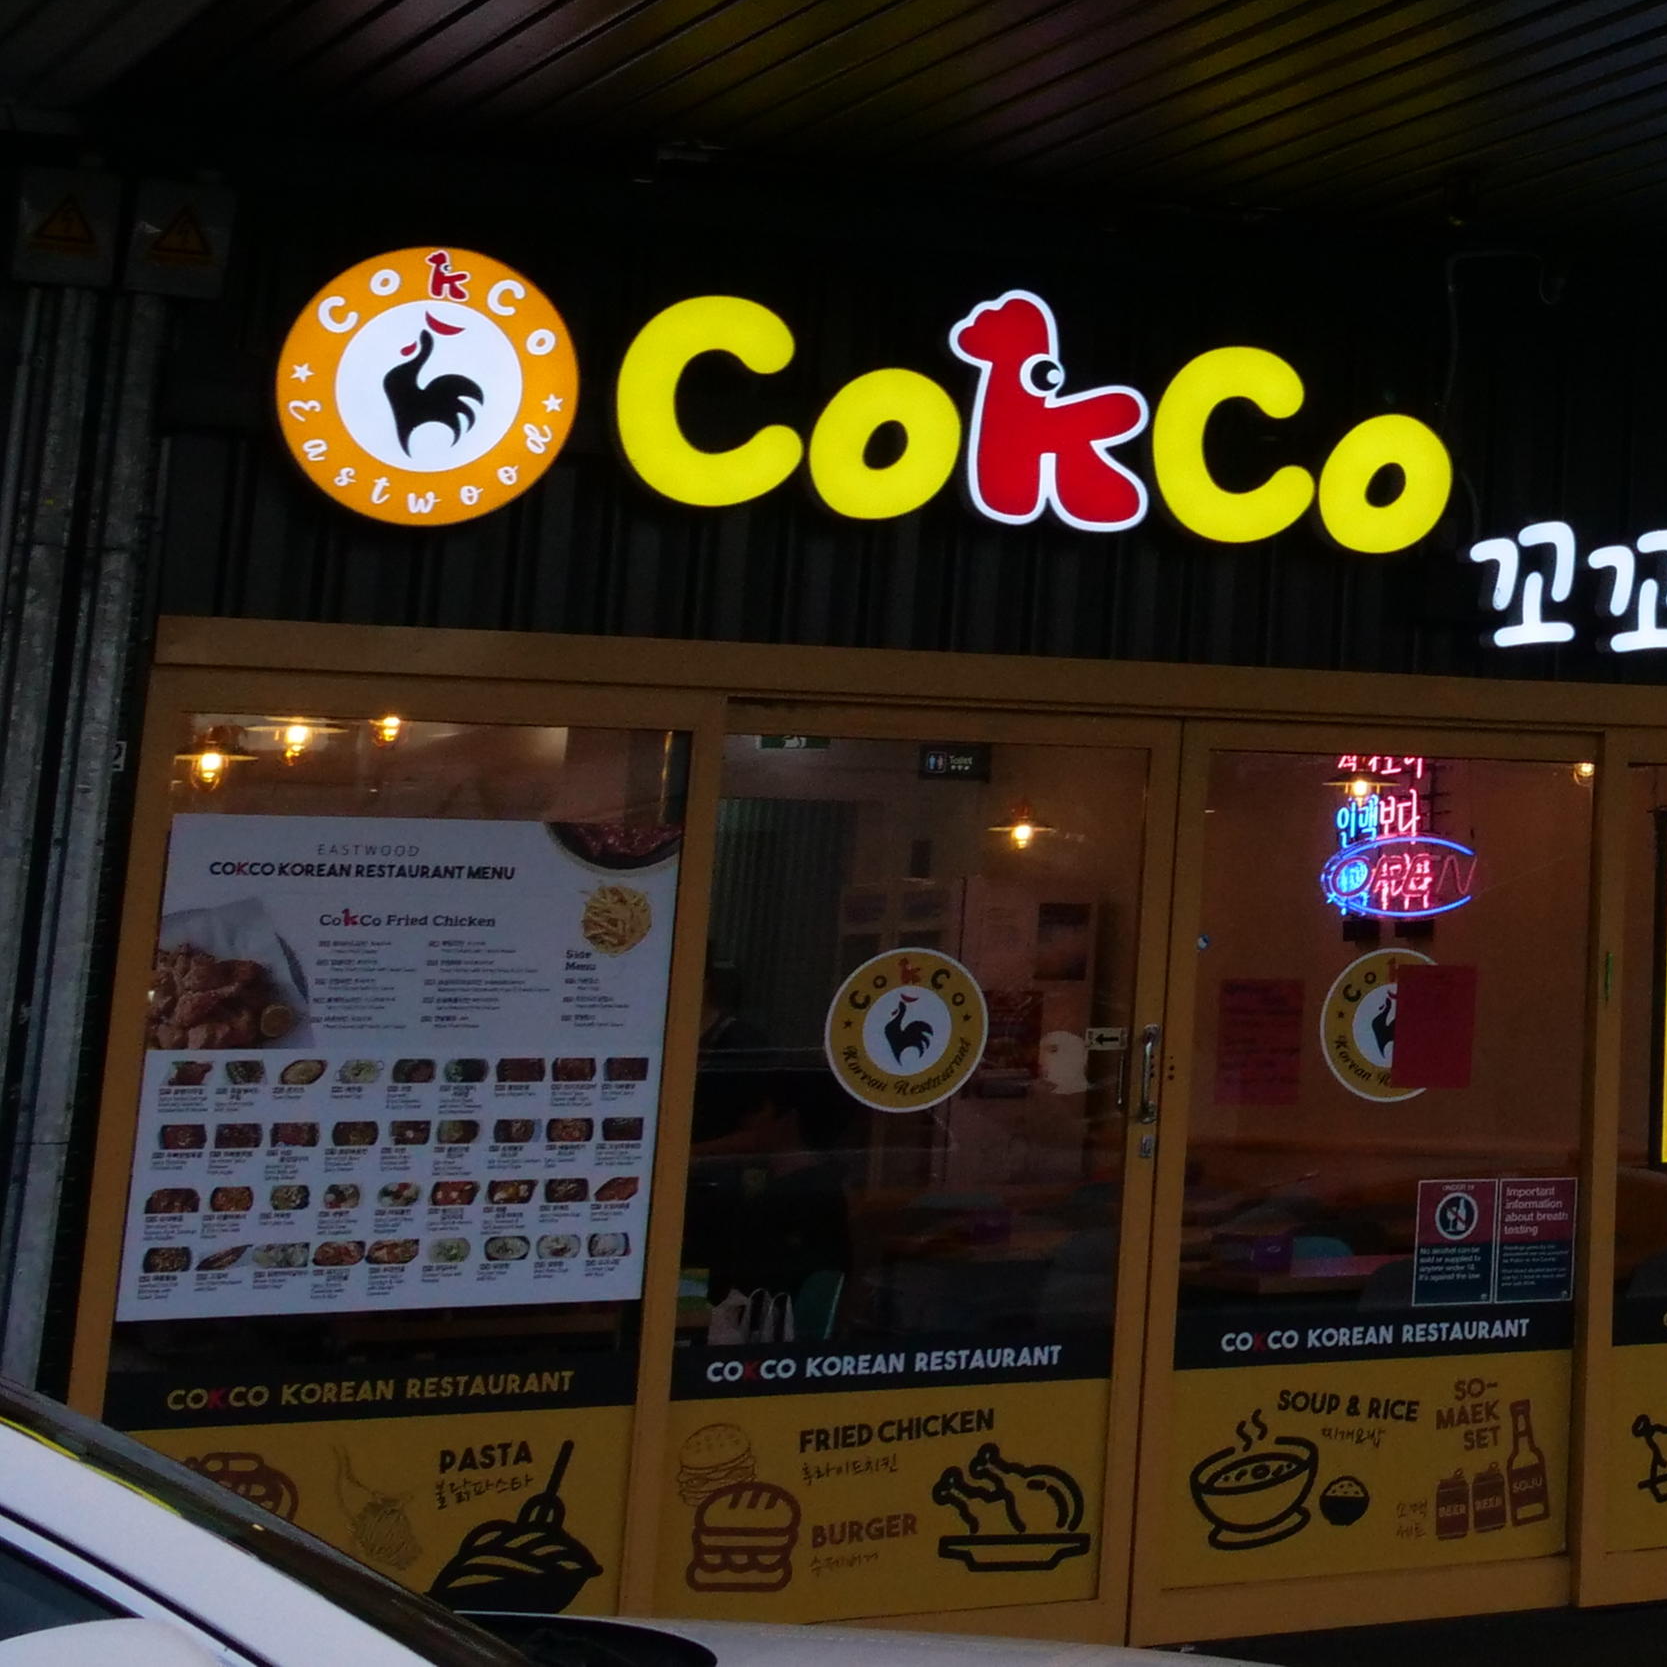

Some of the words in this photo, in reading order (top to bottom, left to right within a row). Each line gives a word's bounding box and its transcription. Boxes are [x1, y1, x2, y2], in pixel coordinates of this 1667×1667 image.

[316, 843, 420, 858] EASTWOOD
[278, 862, 352, 879] KOREAN
[355, 863, 464, 880] RESTAURANT
[466, 865, 514, 880] MENU
[386, 912, 428, 928] Fried
[432, 913, 496, 928] Chicken
[1504, 1199, 1562, 1209] information
[1506, 1187, 1555, 1196] Important
[1504, 1212, 1534, 1222] about
[1307, 1324, 1393, 1348] KOREAN
[1402, 1318, 1530, 1344] RESTAURANT
[805, 1353, 905, 1378] KOREAN
[915, 1344, 1062, 1372] RESTAURANT
[280, 1379, 395, 1406] KOREAN
[406, 1370, 576, 1400] RESTAURANT
[1278, 1389, 1339, 1415] SOUP
[1347, 1395, 1360, 1416] &
[1368, 1398, 1420, 1422] RICE
[1436, 1399, 1500, 1429] MAEK
[800, 1424, 873, 1453] FRIED
[878, 1408, 994, 1443] CHICKEN
[1464, 1426, 1501, 1452] SET
[439, 1441, 532, 1474] PASTA
[811, 1513, 918, 1548] BURGER
